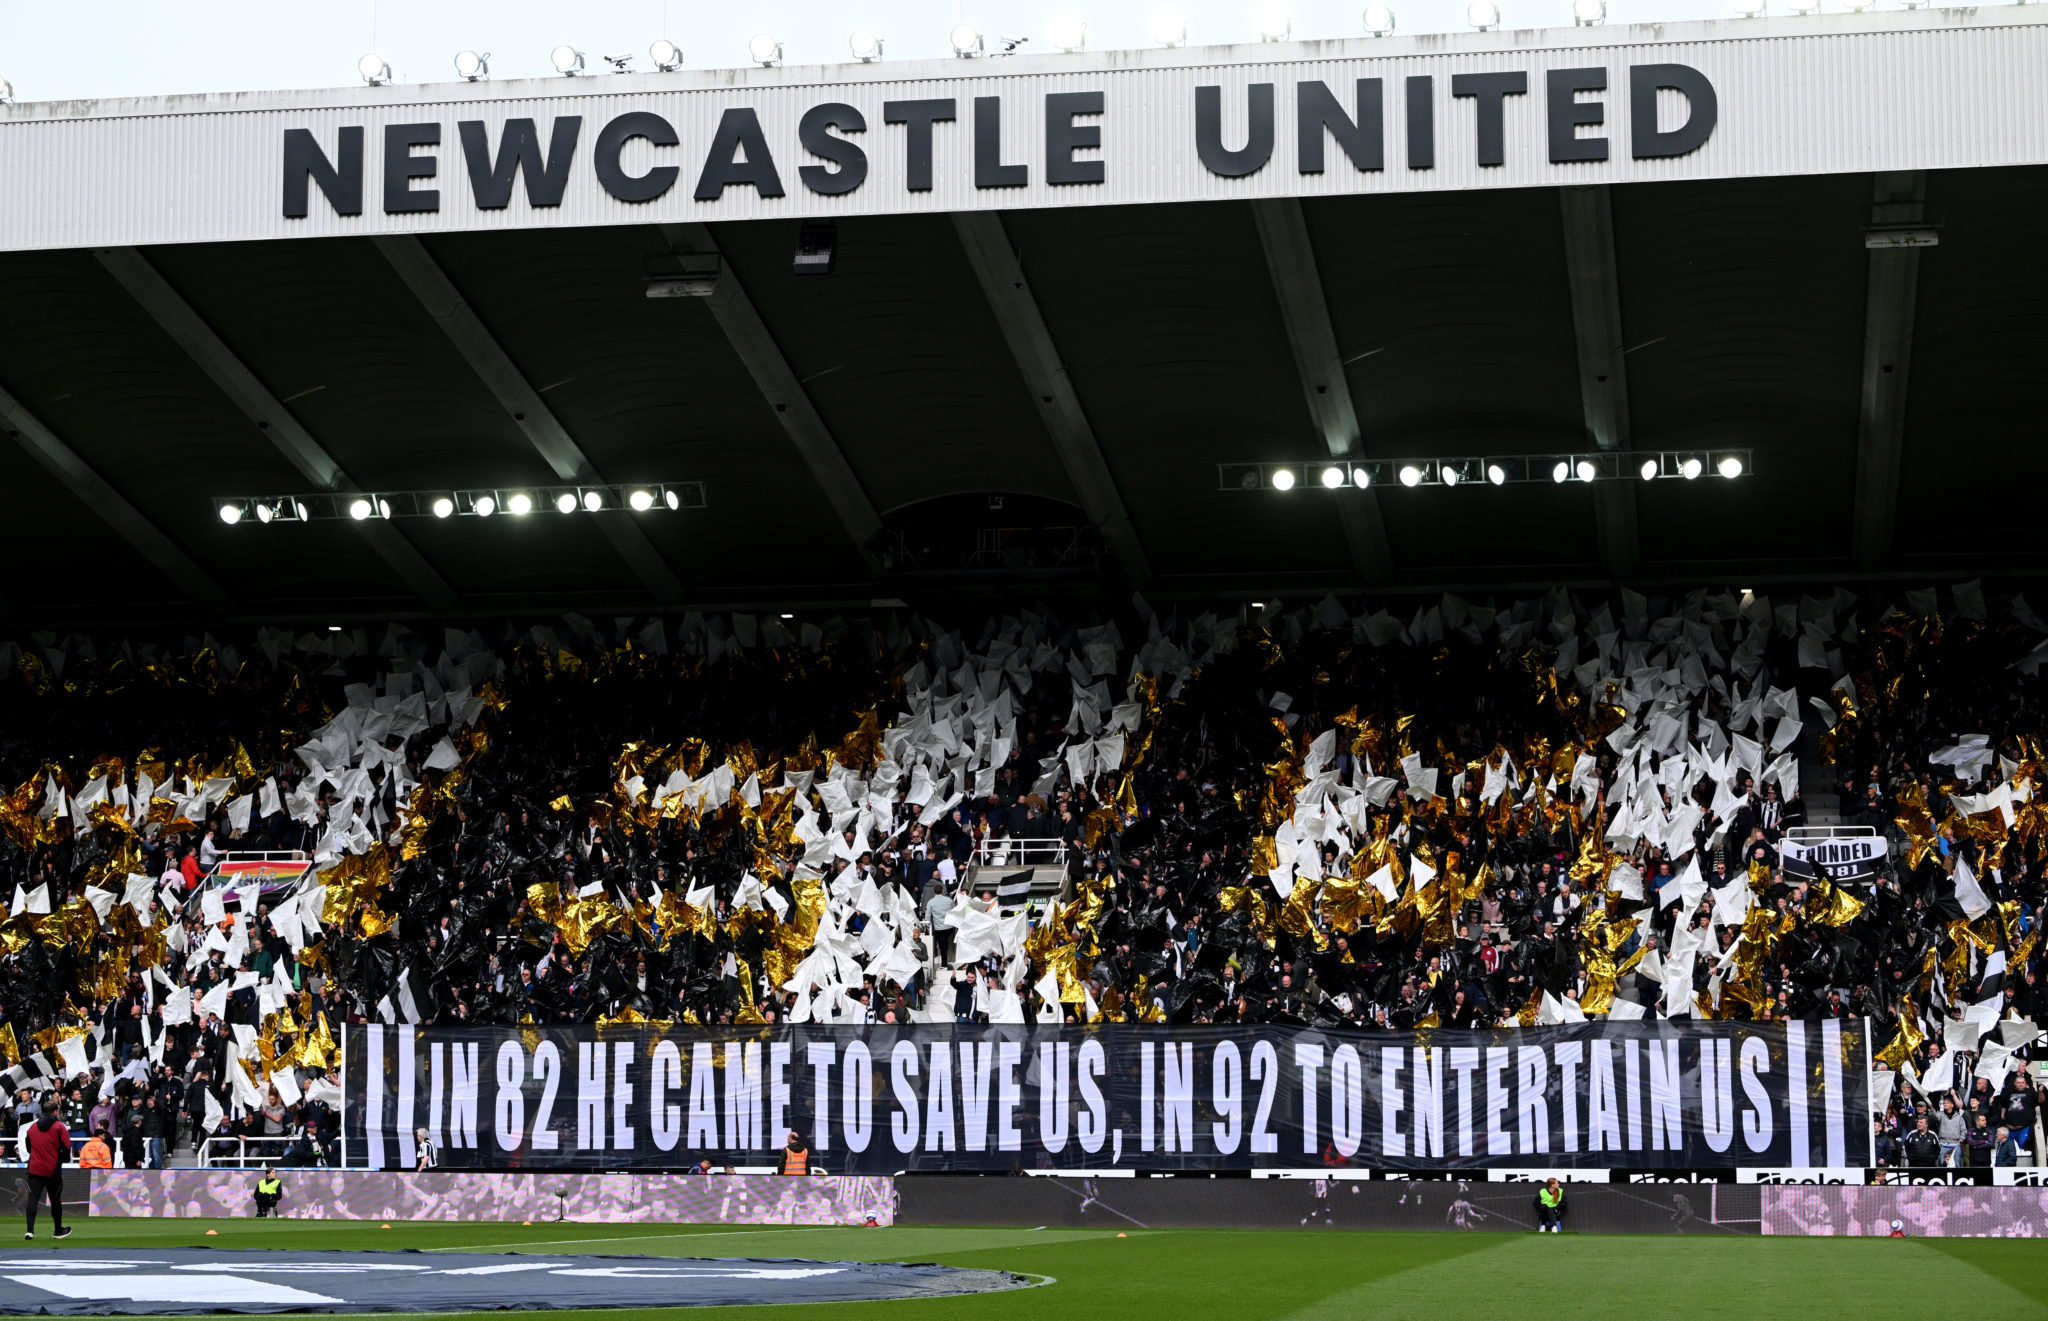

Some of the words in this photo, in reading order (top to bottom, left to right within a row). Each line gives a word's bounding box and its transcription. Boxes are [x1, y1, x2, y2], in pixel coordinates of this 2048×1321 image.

[283, 92, 1104, 220] NEWCASTLE
[1196, 64, 1717, 180] UNITED
[429, 1042, 478, 1149] IN
[496, 1040, 560, 1151] 82
[578, 1042, 634, 1149] HE
[651, 1038, 792, 1151] CAME
[807, 1040, 872, 1152] TO
[891, 1040, 1021, 1153] SAVE
[1040, 1040, 1122, 1165] US,
[1141, 1042, 1193, 1152] IN
[1213, 1040, 1278, 1154] 92
[1295, 1044, 1362, 1156] TO
[1382, 1039, 1682, 1157] ENTERTAIN
[1700, 1037, 1772, 1152] US
